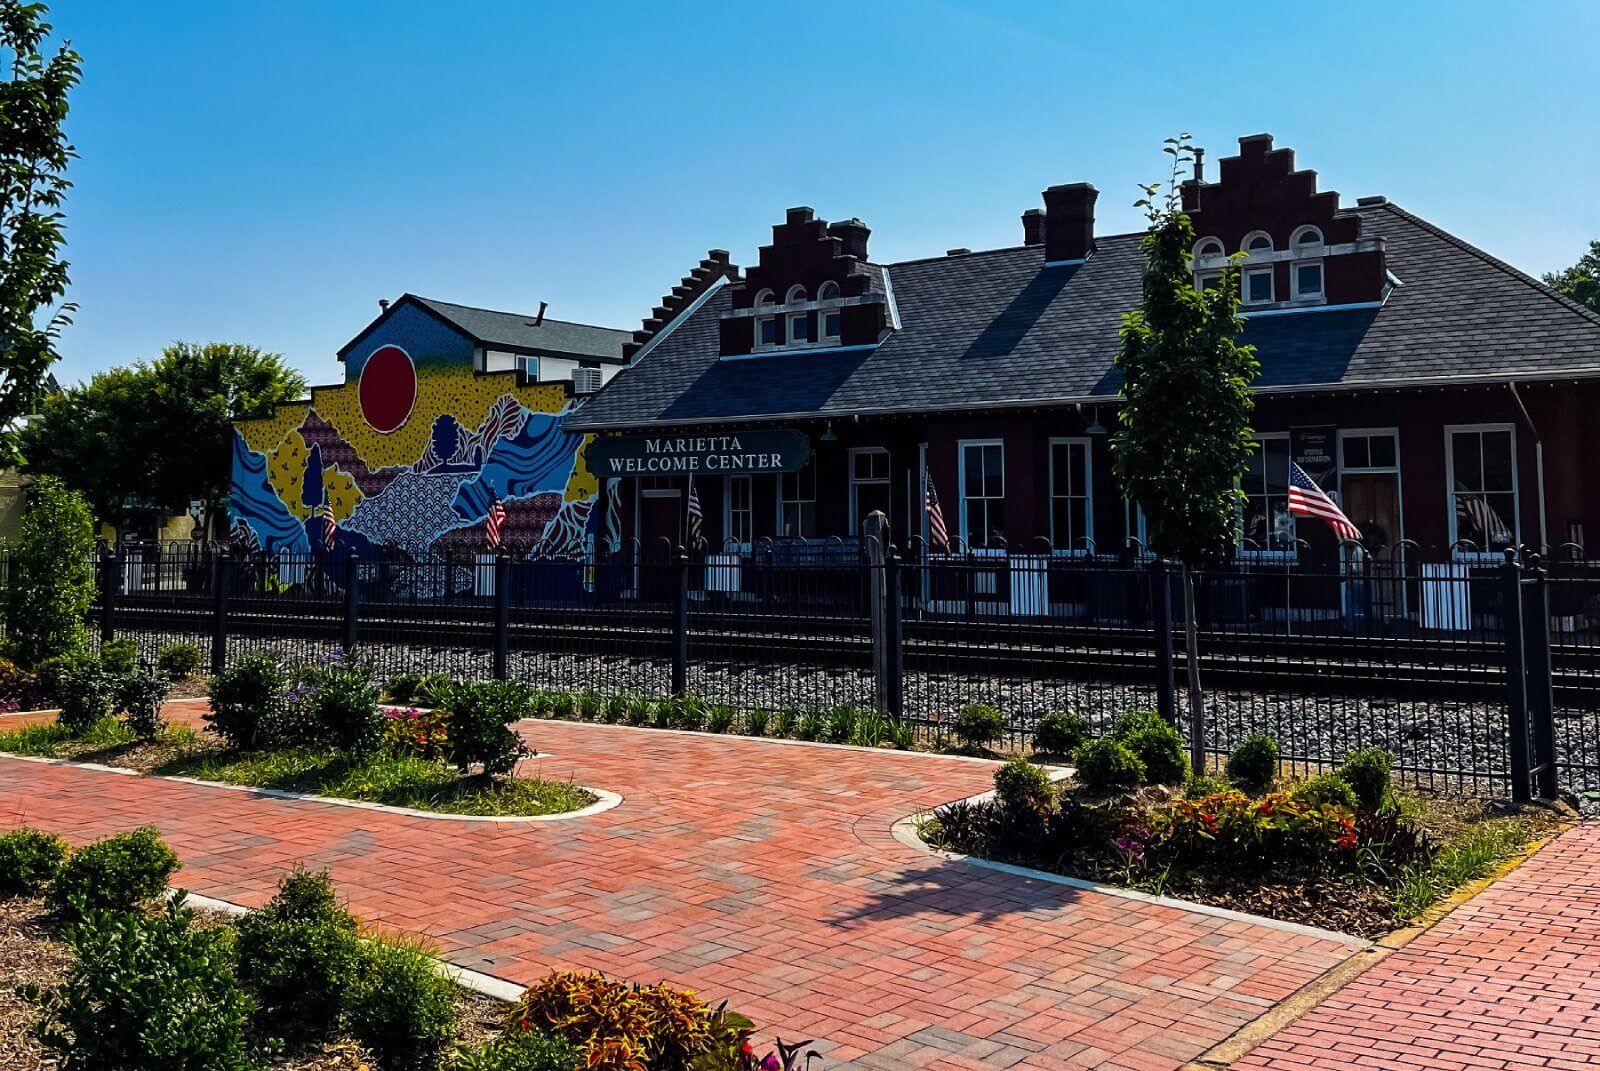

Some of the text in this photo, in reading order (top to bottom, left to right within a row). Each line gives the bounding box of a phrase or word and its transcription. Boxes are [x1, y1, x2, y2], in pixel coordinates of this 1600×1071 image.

[645, 436, 742, 453] MARIETTA
[609, 453, 783, 472] WELCOME CENTER
